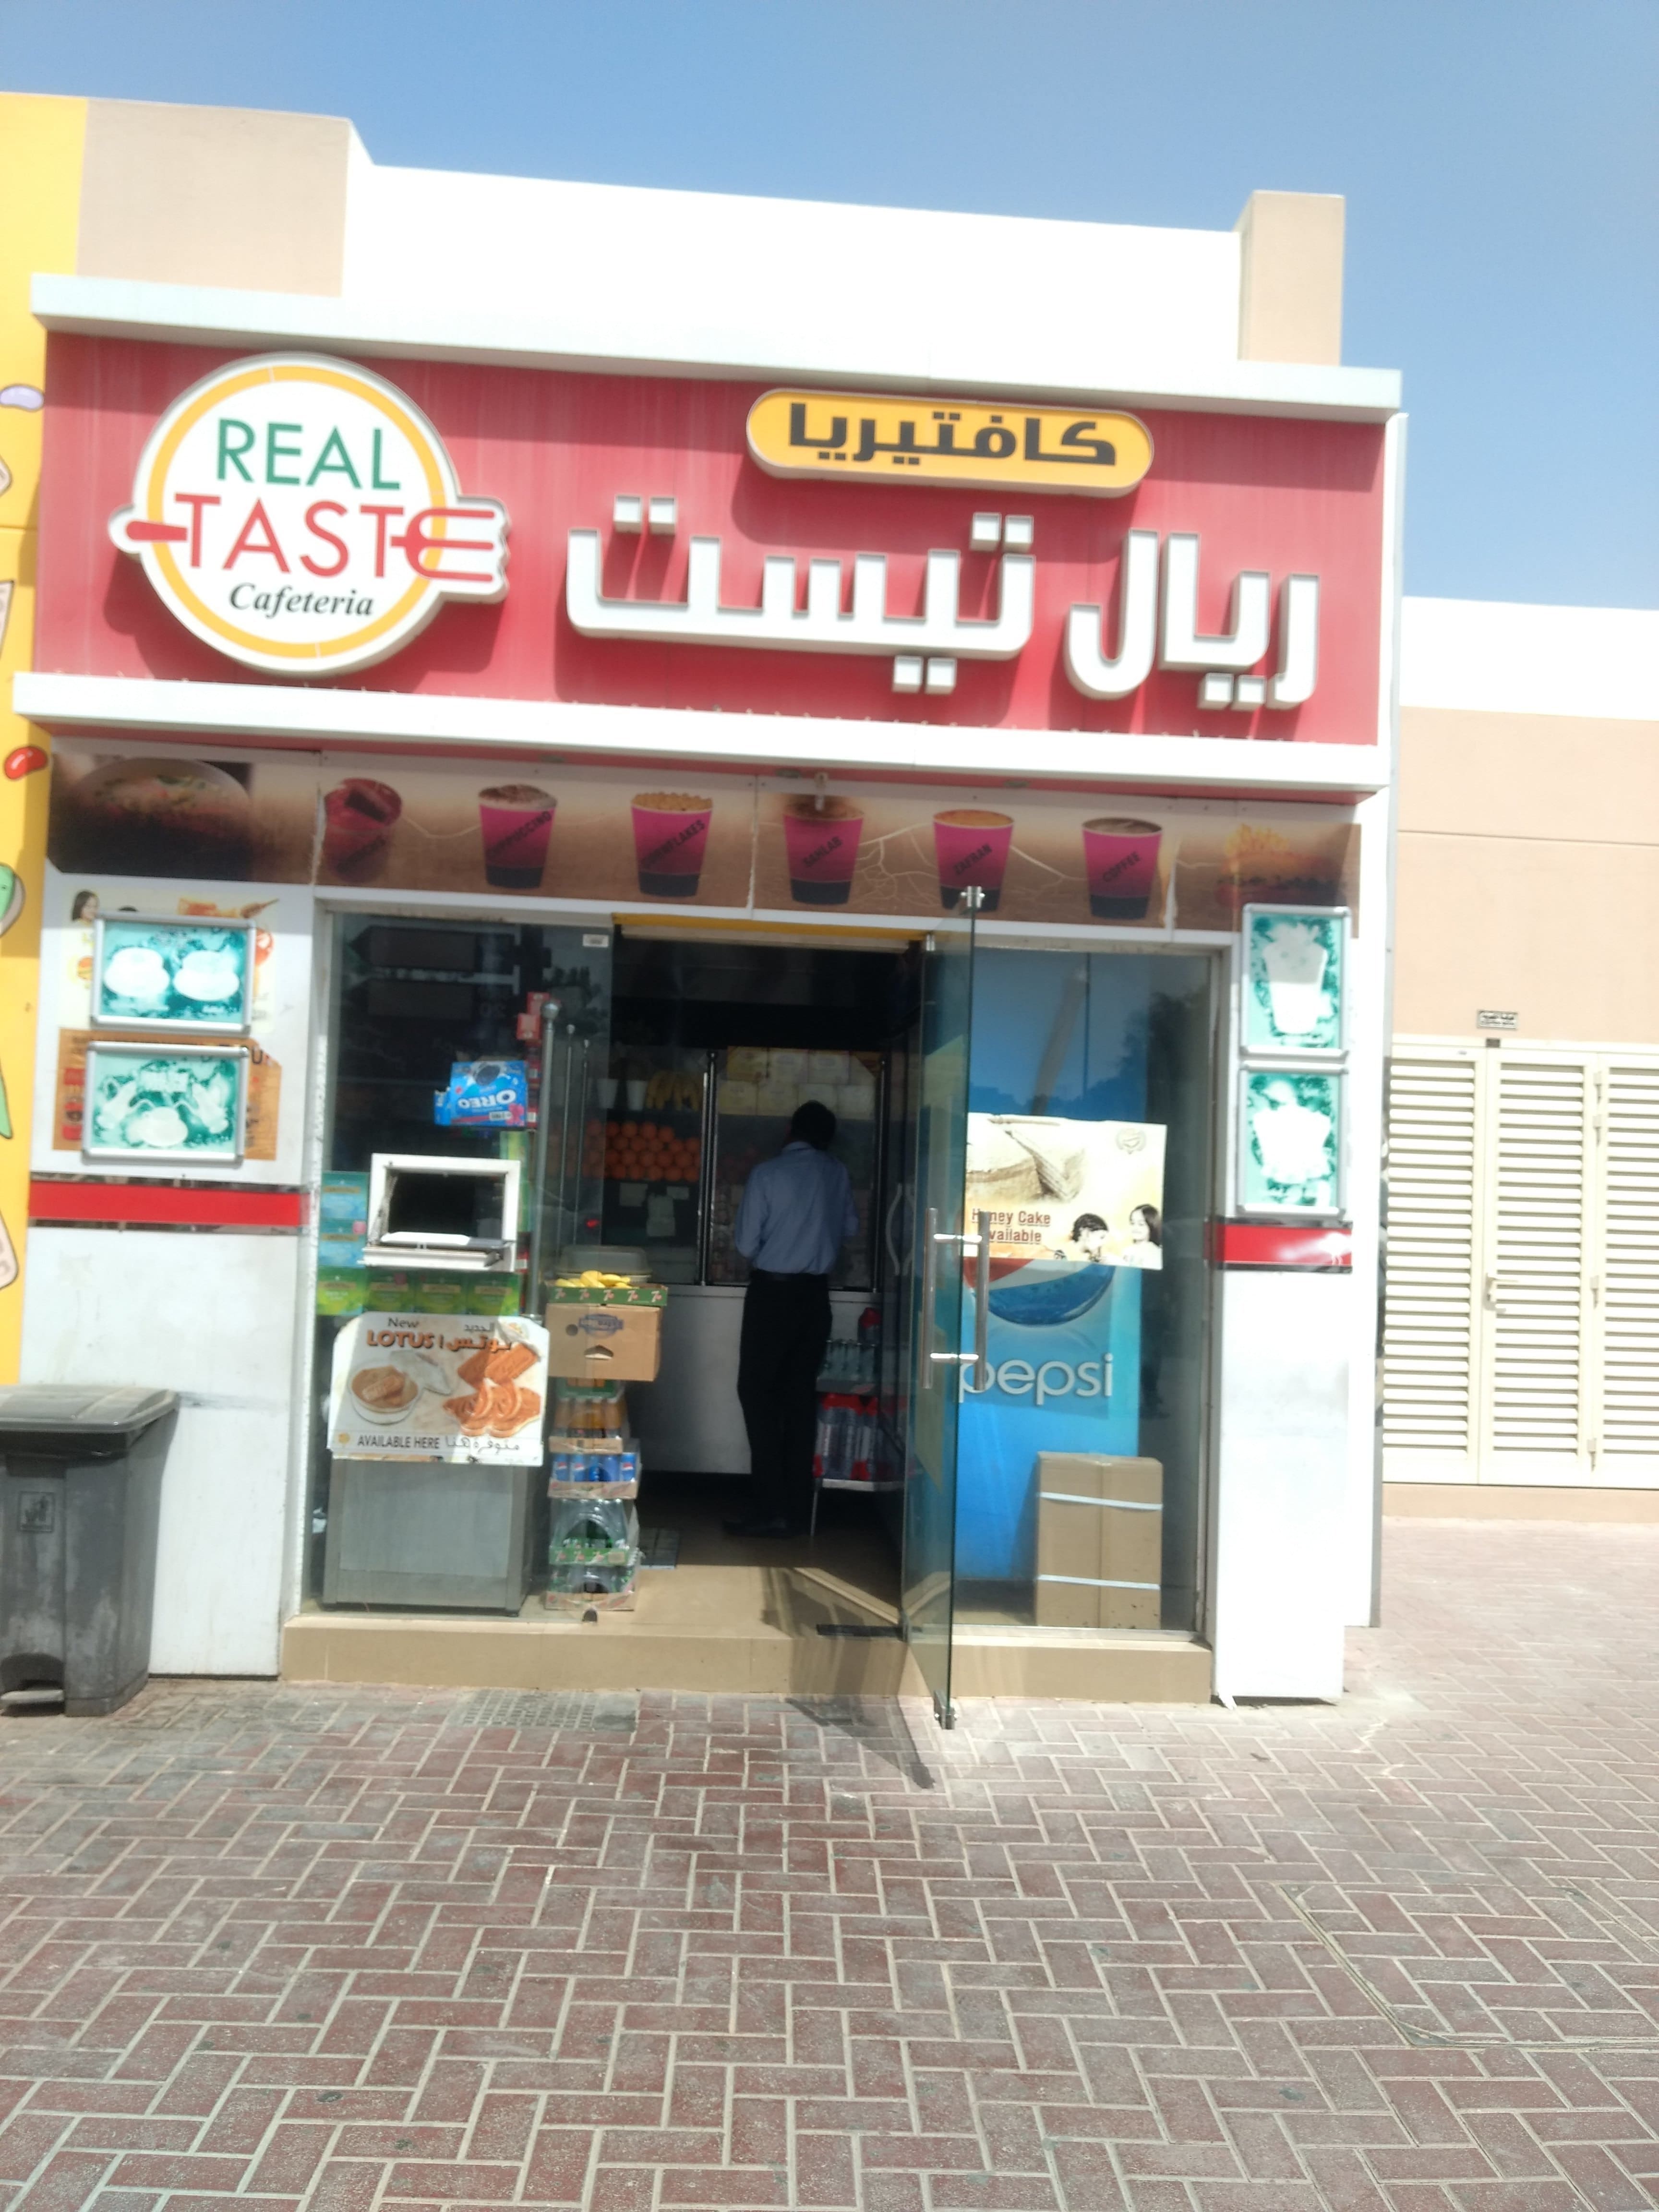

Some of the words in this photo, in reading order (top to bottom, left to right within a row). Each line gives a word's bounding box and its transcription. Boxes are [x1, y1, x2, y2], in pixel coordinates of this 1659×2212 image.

[789, 402, 1116, 466] كافتيريا
[216, 418, 401, 490] REAL
[174, 493, 495, 583] TASTE
[229, 582, 374, 619] Cafeteria
[566, 495, 1036, 695] تيست
[1065, 529, 1319, 709] ريال
[640, 819, 705, 868] NFLAKES
[1103, 851, 1141, 882] COFFEE
[457, 1089, 517, 1109] OREO
[972, 1208, 1013, 1226] Hney
[1018, 1210, 1051, 1225] Cake
[989, 1228, 1042, 1242] vailable
[366, 1329, 435, 1350] LOTUS
[387, 1317, 419, 1328] New
[959, 1353, 1113, 1406] pepsi
[357, 1435, 411, 1448] AVAILABLE
[413, 1436, 440, 1449] HERE
